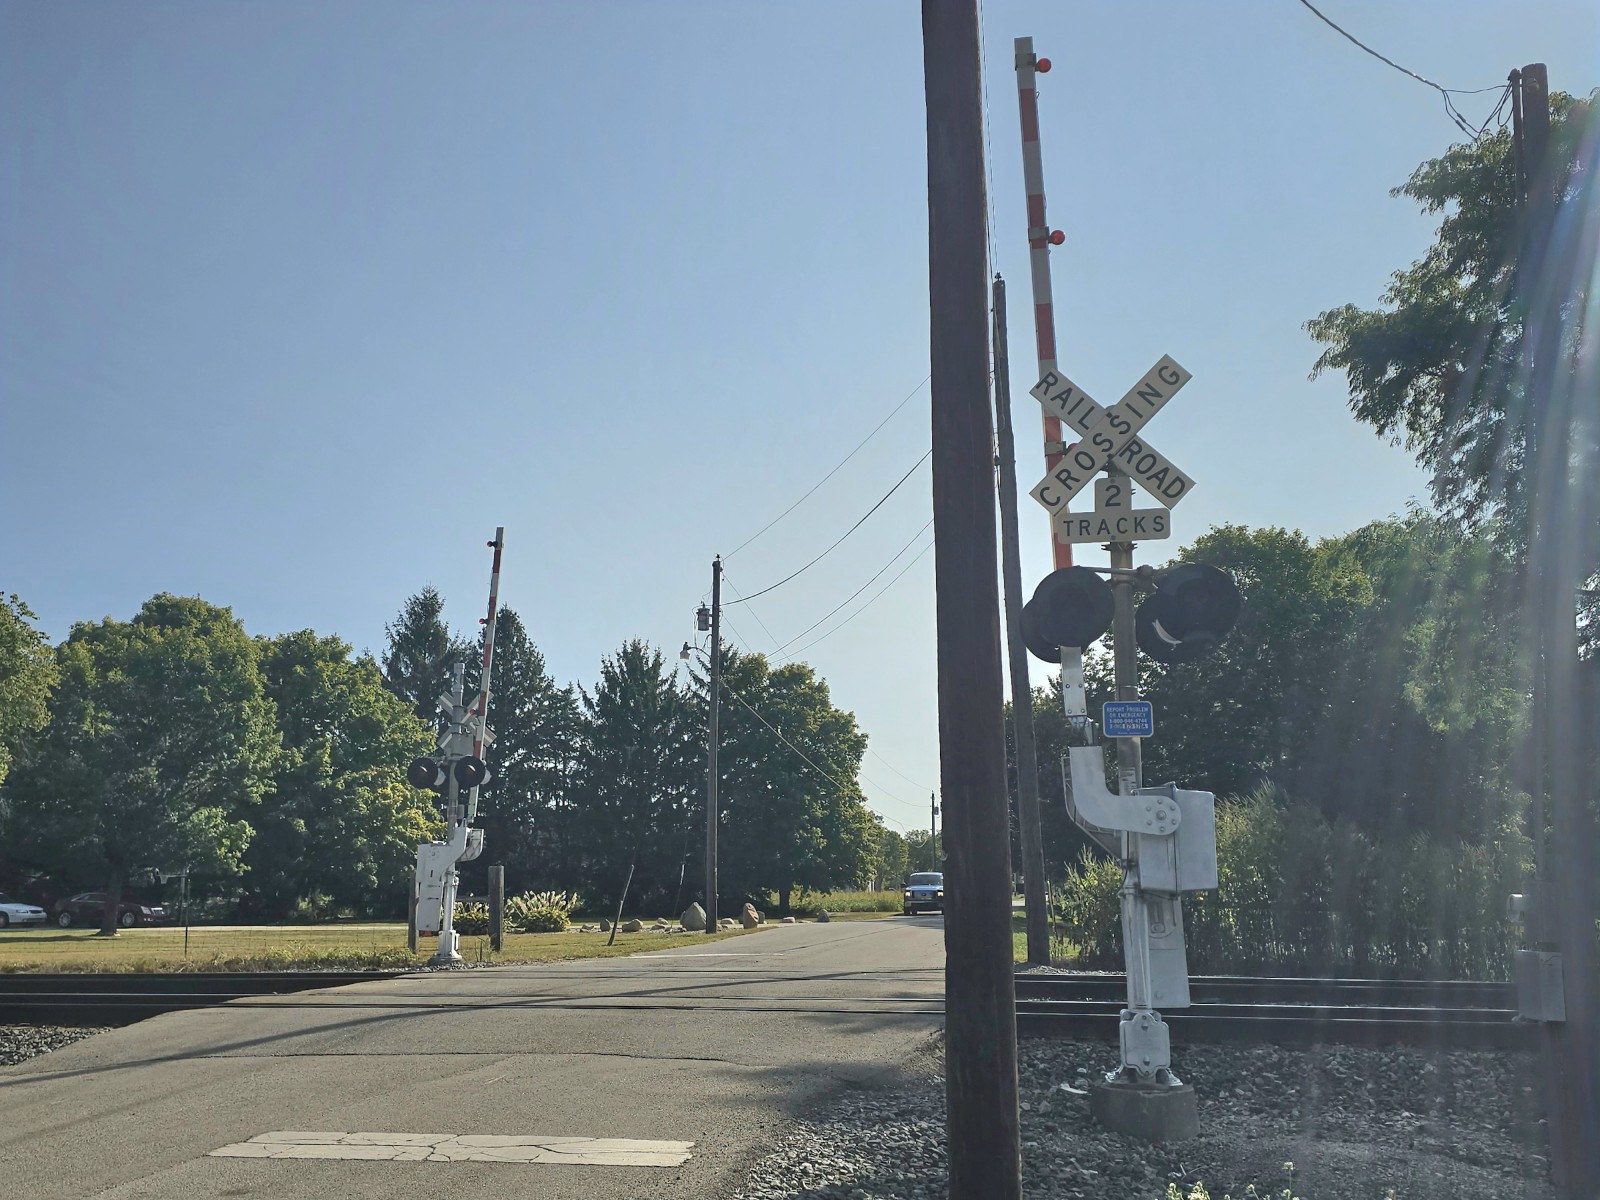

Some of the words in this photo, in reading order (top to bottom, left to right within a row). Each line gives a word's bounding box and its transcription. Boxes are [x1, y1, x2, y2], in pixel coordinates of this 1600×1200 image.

[1035, 371, 1096, 431] RAIL
[1118, 440, 1186, 499] ROAD
[1039, 365, 1181, 507] CROSSING
[1063, 515, 1165, 537] TRACKS
[1105, 484, 1121, 508] 2
